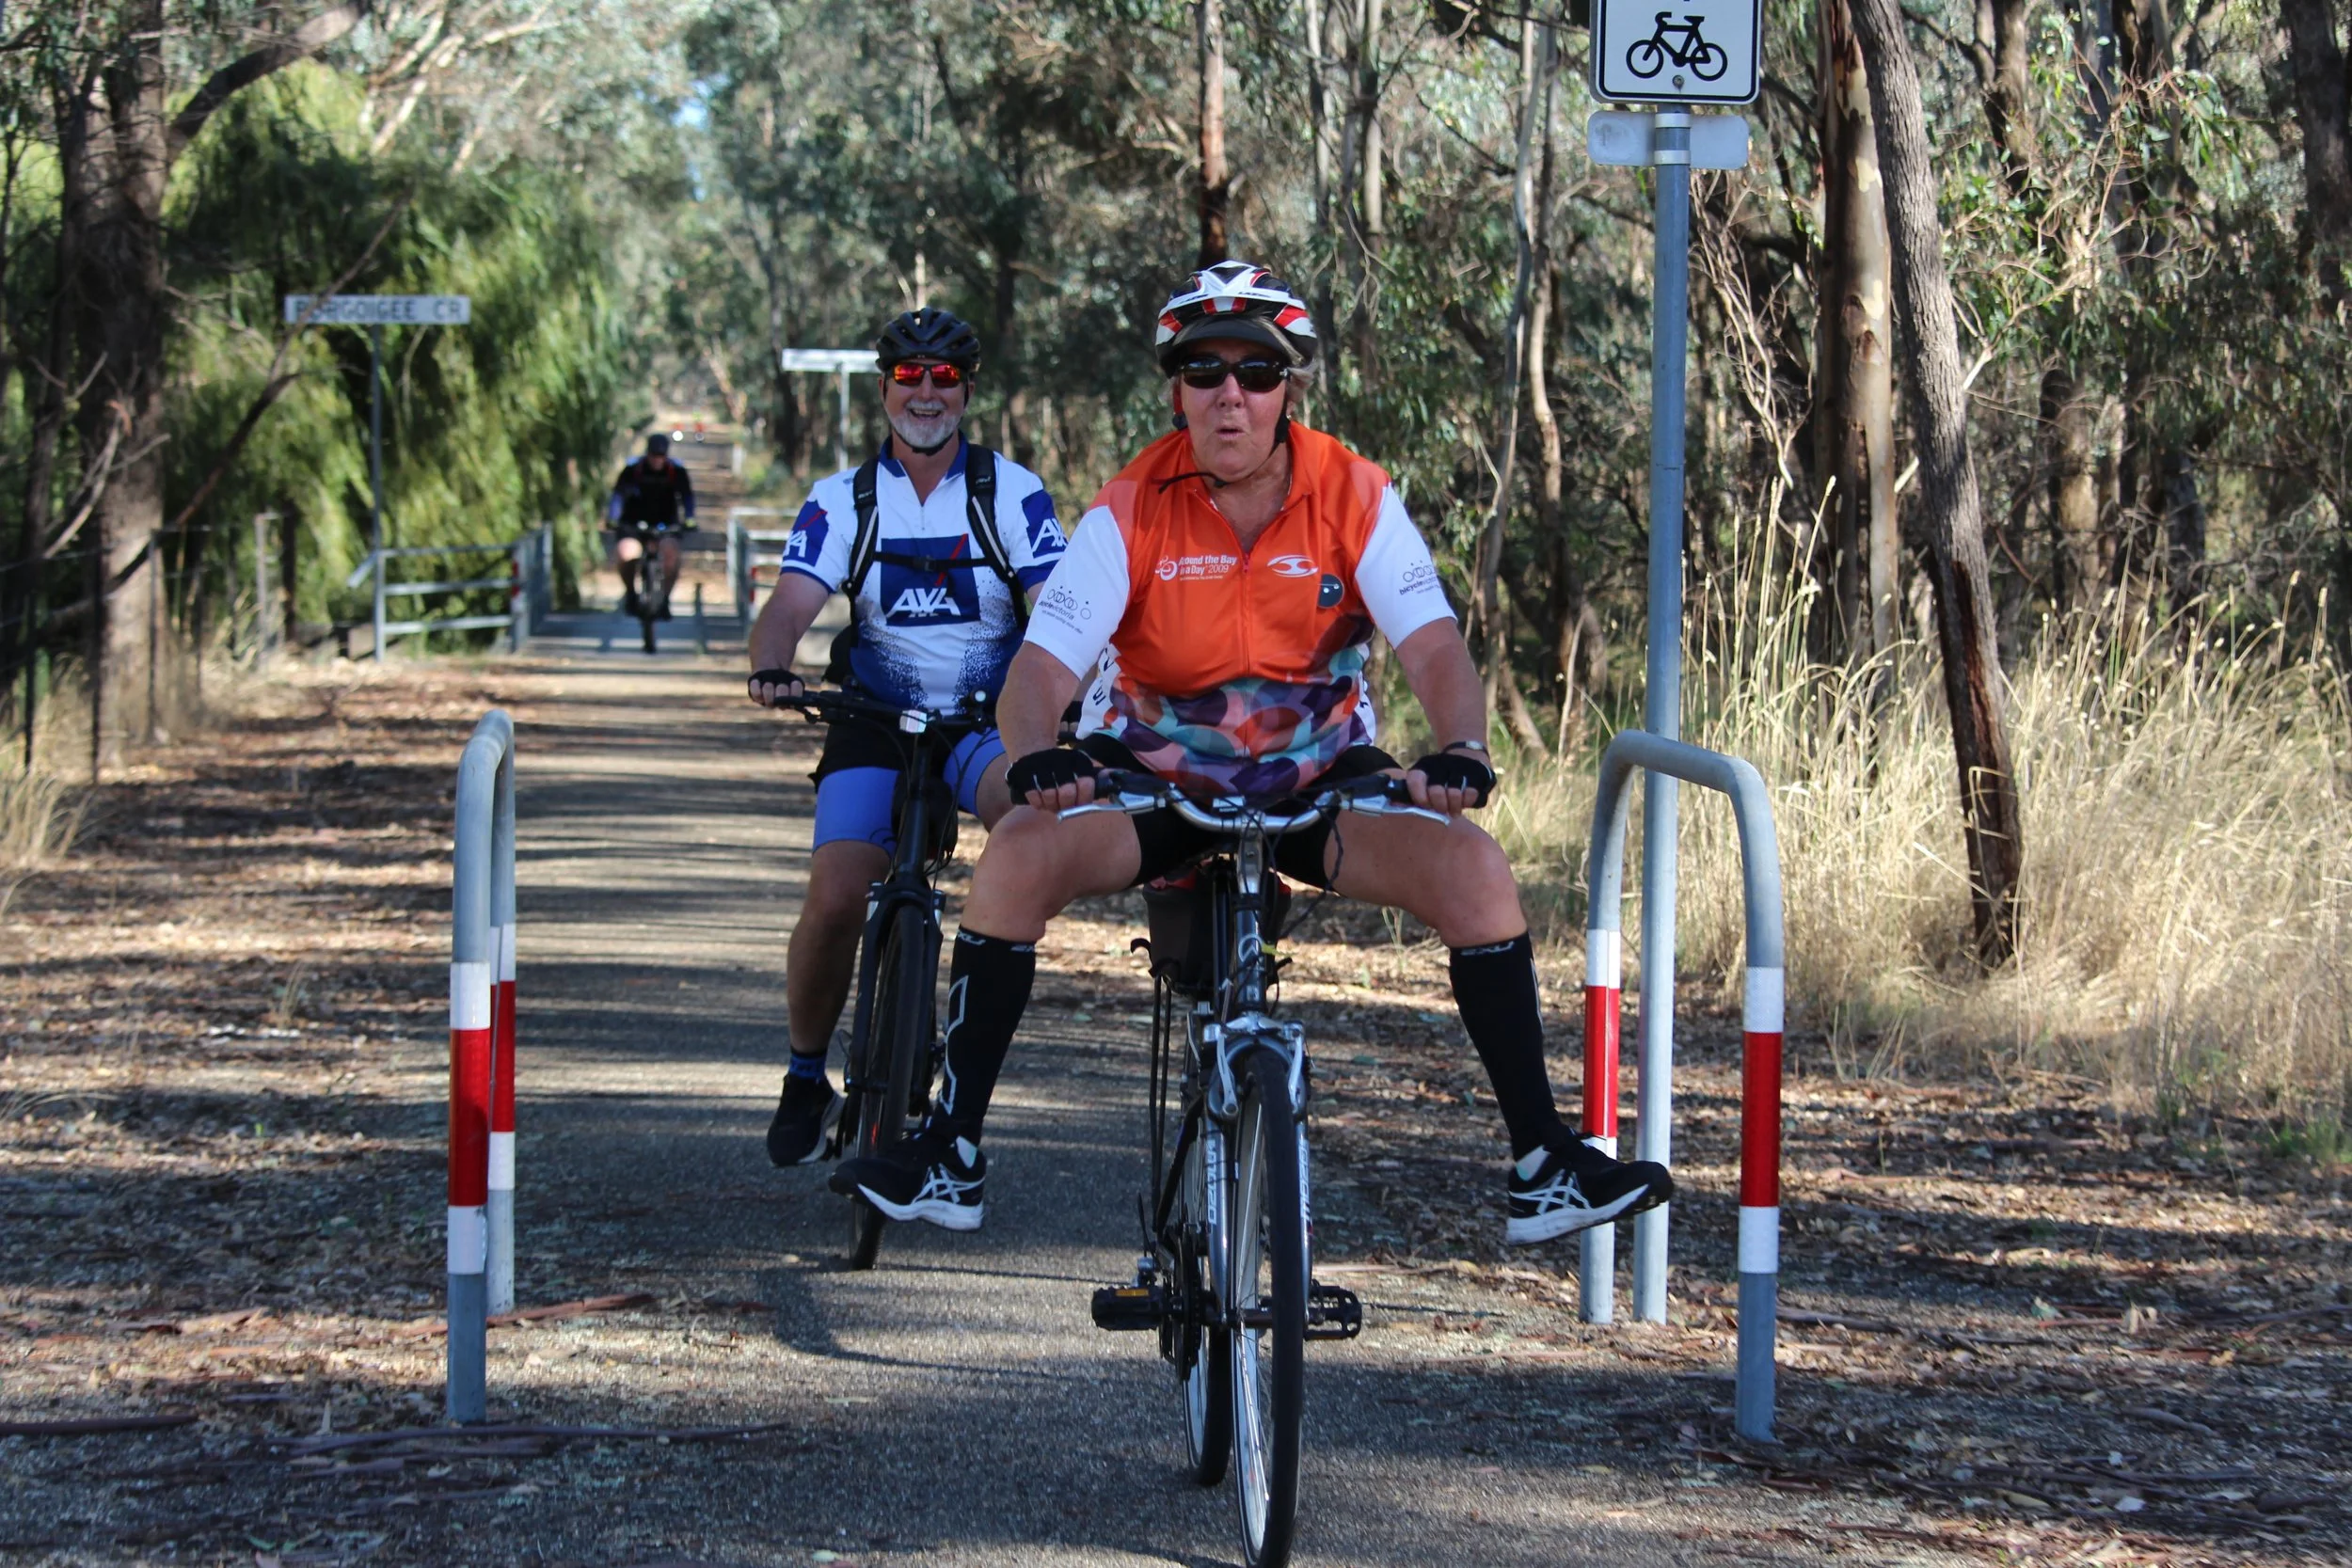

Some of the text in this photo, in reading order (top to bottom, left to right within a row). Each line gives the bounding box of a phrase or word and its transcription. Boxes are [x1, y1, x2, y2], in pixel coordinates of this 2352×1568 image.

[433, 299, 461, 320] CR
[1205, 555, 1218, 564] the
[1220, 555, 1237, 565] Bay
[1191, 565, 1205, 576] Day
[885, 587, 961, 619] AXA
